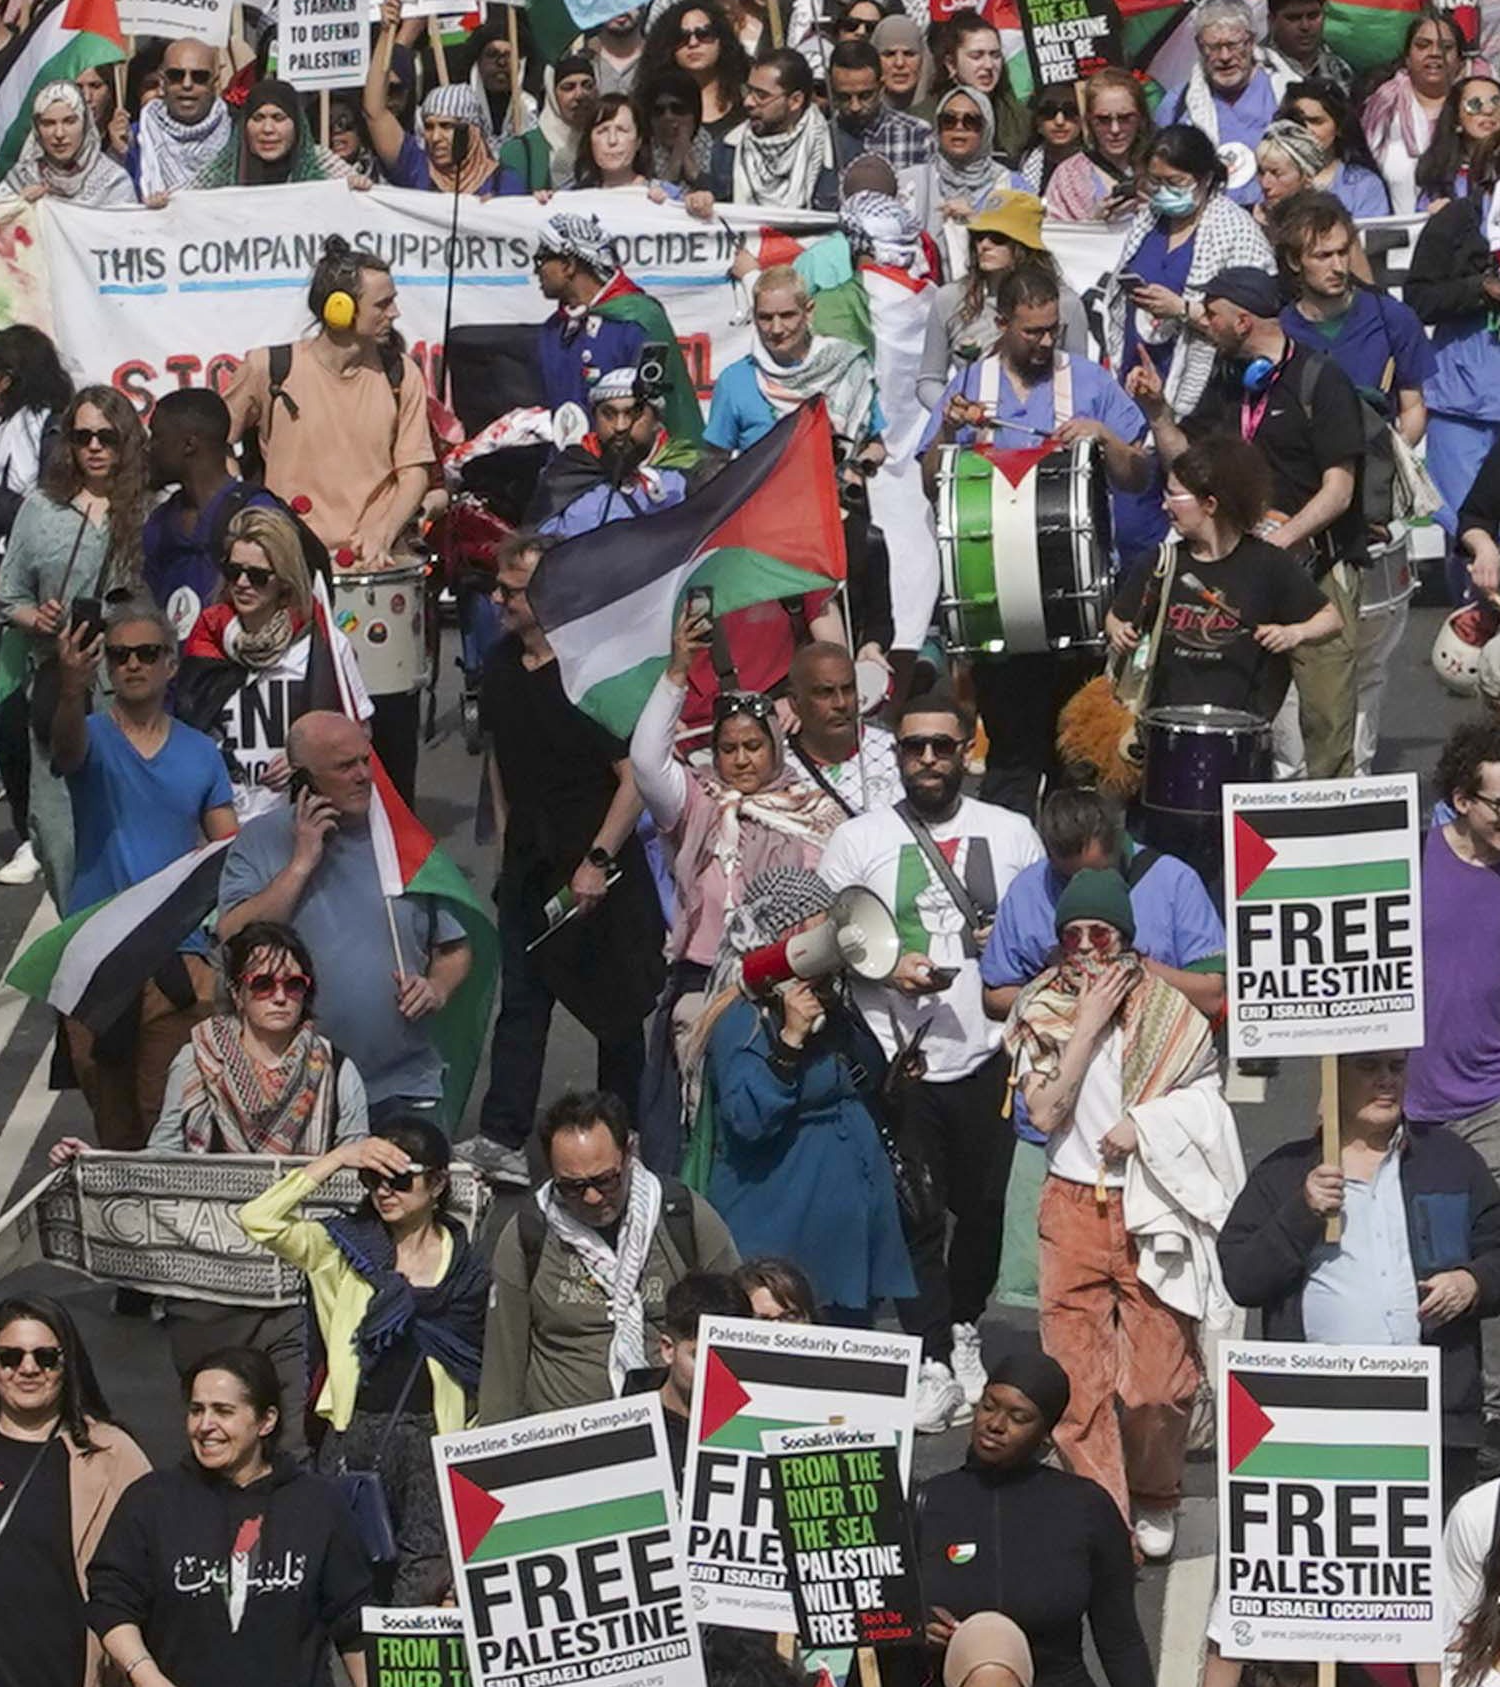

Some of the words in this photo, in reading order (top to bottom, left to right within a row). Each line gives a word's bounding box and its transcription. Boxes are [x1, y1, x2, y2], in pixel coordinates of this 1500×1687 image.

[312, 20, 360, 43] DEFEND
[1033, 16, 1110, 47] PALESTINE
[90, 243, 167, 284] THIS
[179, 233, 327, 276] COMPAN
[352, 230, 531, 270] SUPPORTS
[1236, 894, 1414, 968] FREE
[1237, 960, 1415, 1001] PALESTINE
[708, 1326, 770, 1346] Palestine
[774, 1333, 839, 1354] Solidarity
[841, 1340, 912, 1360] Campaign
[1226, 1350, 1287, 1368] Palestine
[1290, 1355, 1356, 1372] Solidarity
[1359, 1356, 1430, 1373] Campaign
[443, 1434, 507, 1459] Palestine
[510, 1420, 579, 1448] Solidarity
[582, 1405, 652, 1434] Campaign
[779, 1454, 840, 1489] FROM
[843, 1451, 885, 1483] THE
[785, 1486, 851, 1519] RIVER
[852, 1482, 879, 1514] TO
[789, 1518, 834, 1551] THE
[836, 1515, 878, 1547] SEA
[1228, 1480, 1433, 1560] FREE
[795, 1545, 906, 1584] PALESTINE
[1228, 1557, 1433, 1597] PALESTINE
[465, 1528, 683, 1640] FREE
[800, 1581, 853, 1614] WILL
[855, 1577, 886, 1611] BE
[1232, 1599, 1264, 1617] END
[1266, 1600, 1329, 1619] ISRAELI
[1330, 1602, 1432, 1621] OCCUPATION
[477, 1602, 689, 1675] PALESTINE
[807, 1613, 859, 1645] FREE
[377, 1637, 440, 1669] FROM
